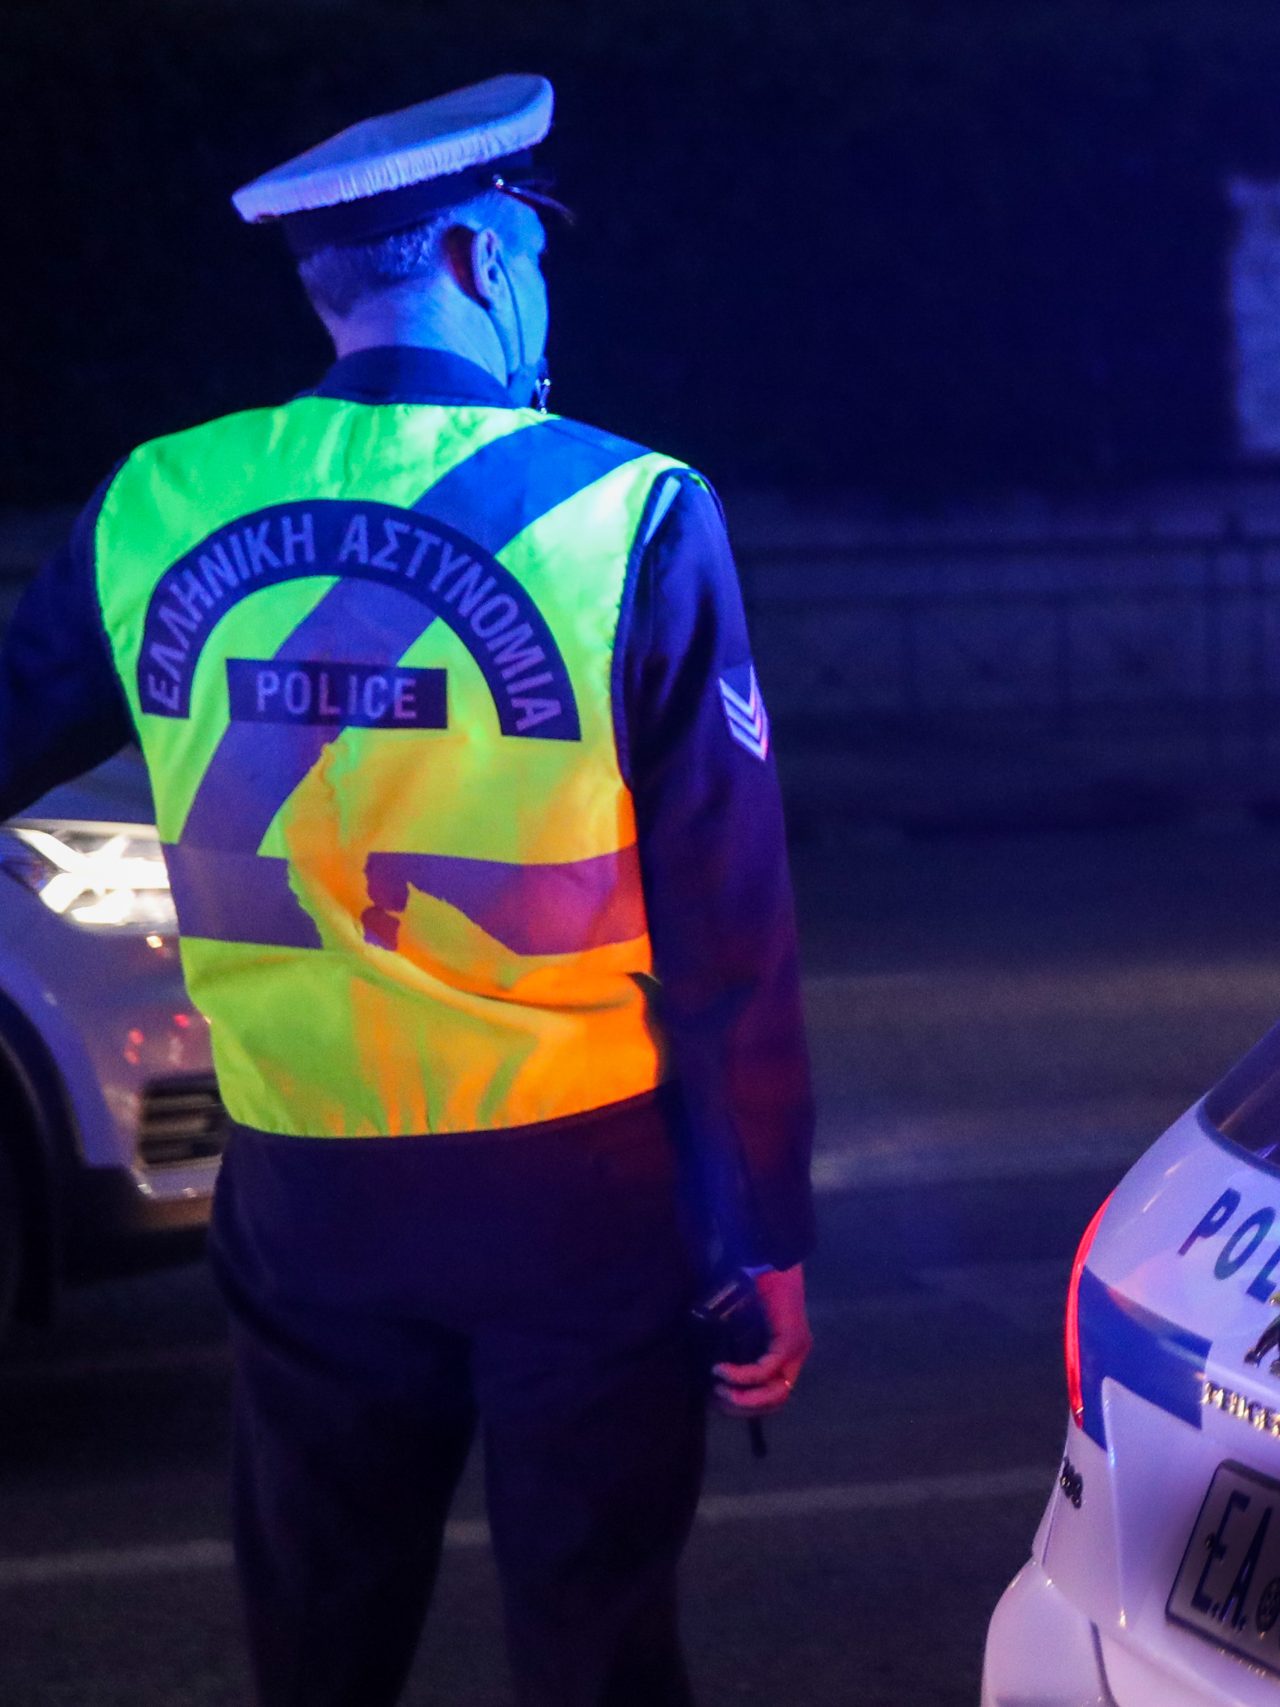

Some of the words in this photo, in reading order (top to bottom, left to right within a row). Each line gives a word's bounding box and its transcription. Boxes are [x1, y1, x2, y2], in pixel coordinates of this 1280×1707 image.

[148, 514, 316, 710] ΕΛΛΗΝΙΚΗ
[339, 515, 562, 733] ΑΣΤΥΝΟΜΙΑ
[256, 671, 417, 719] POLICE
